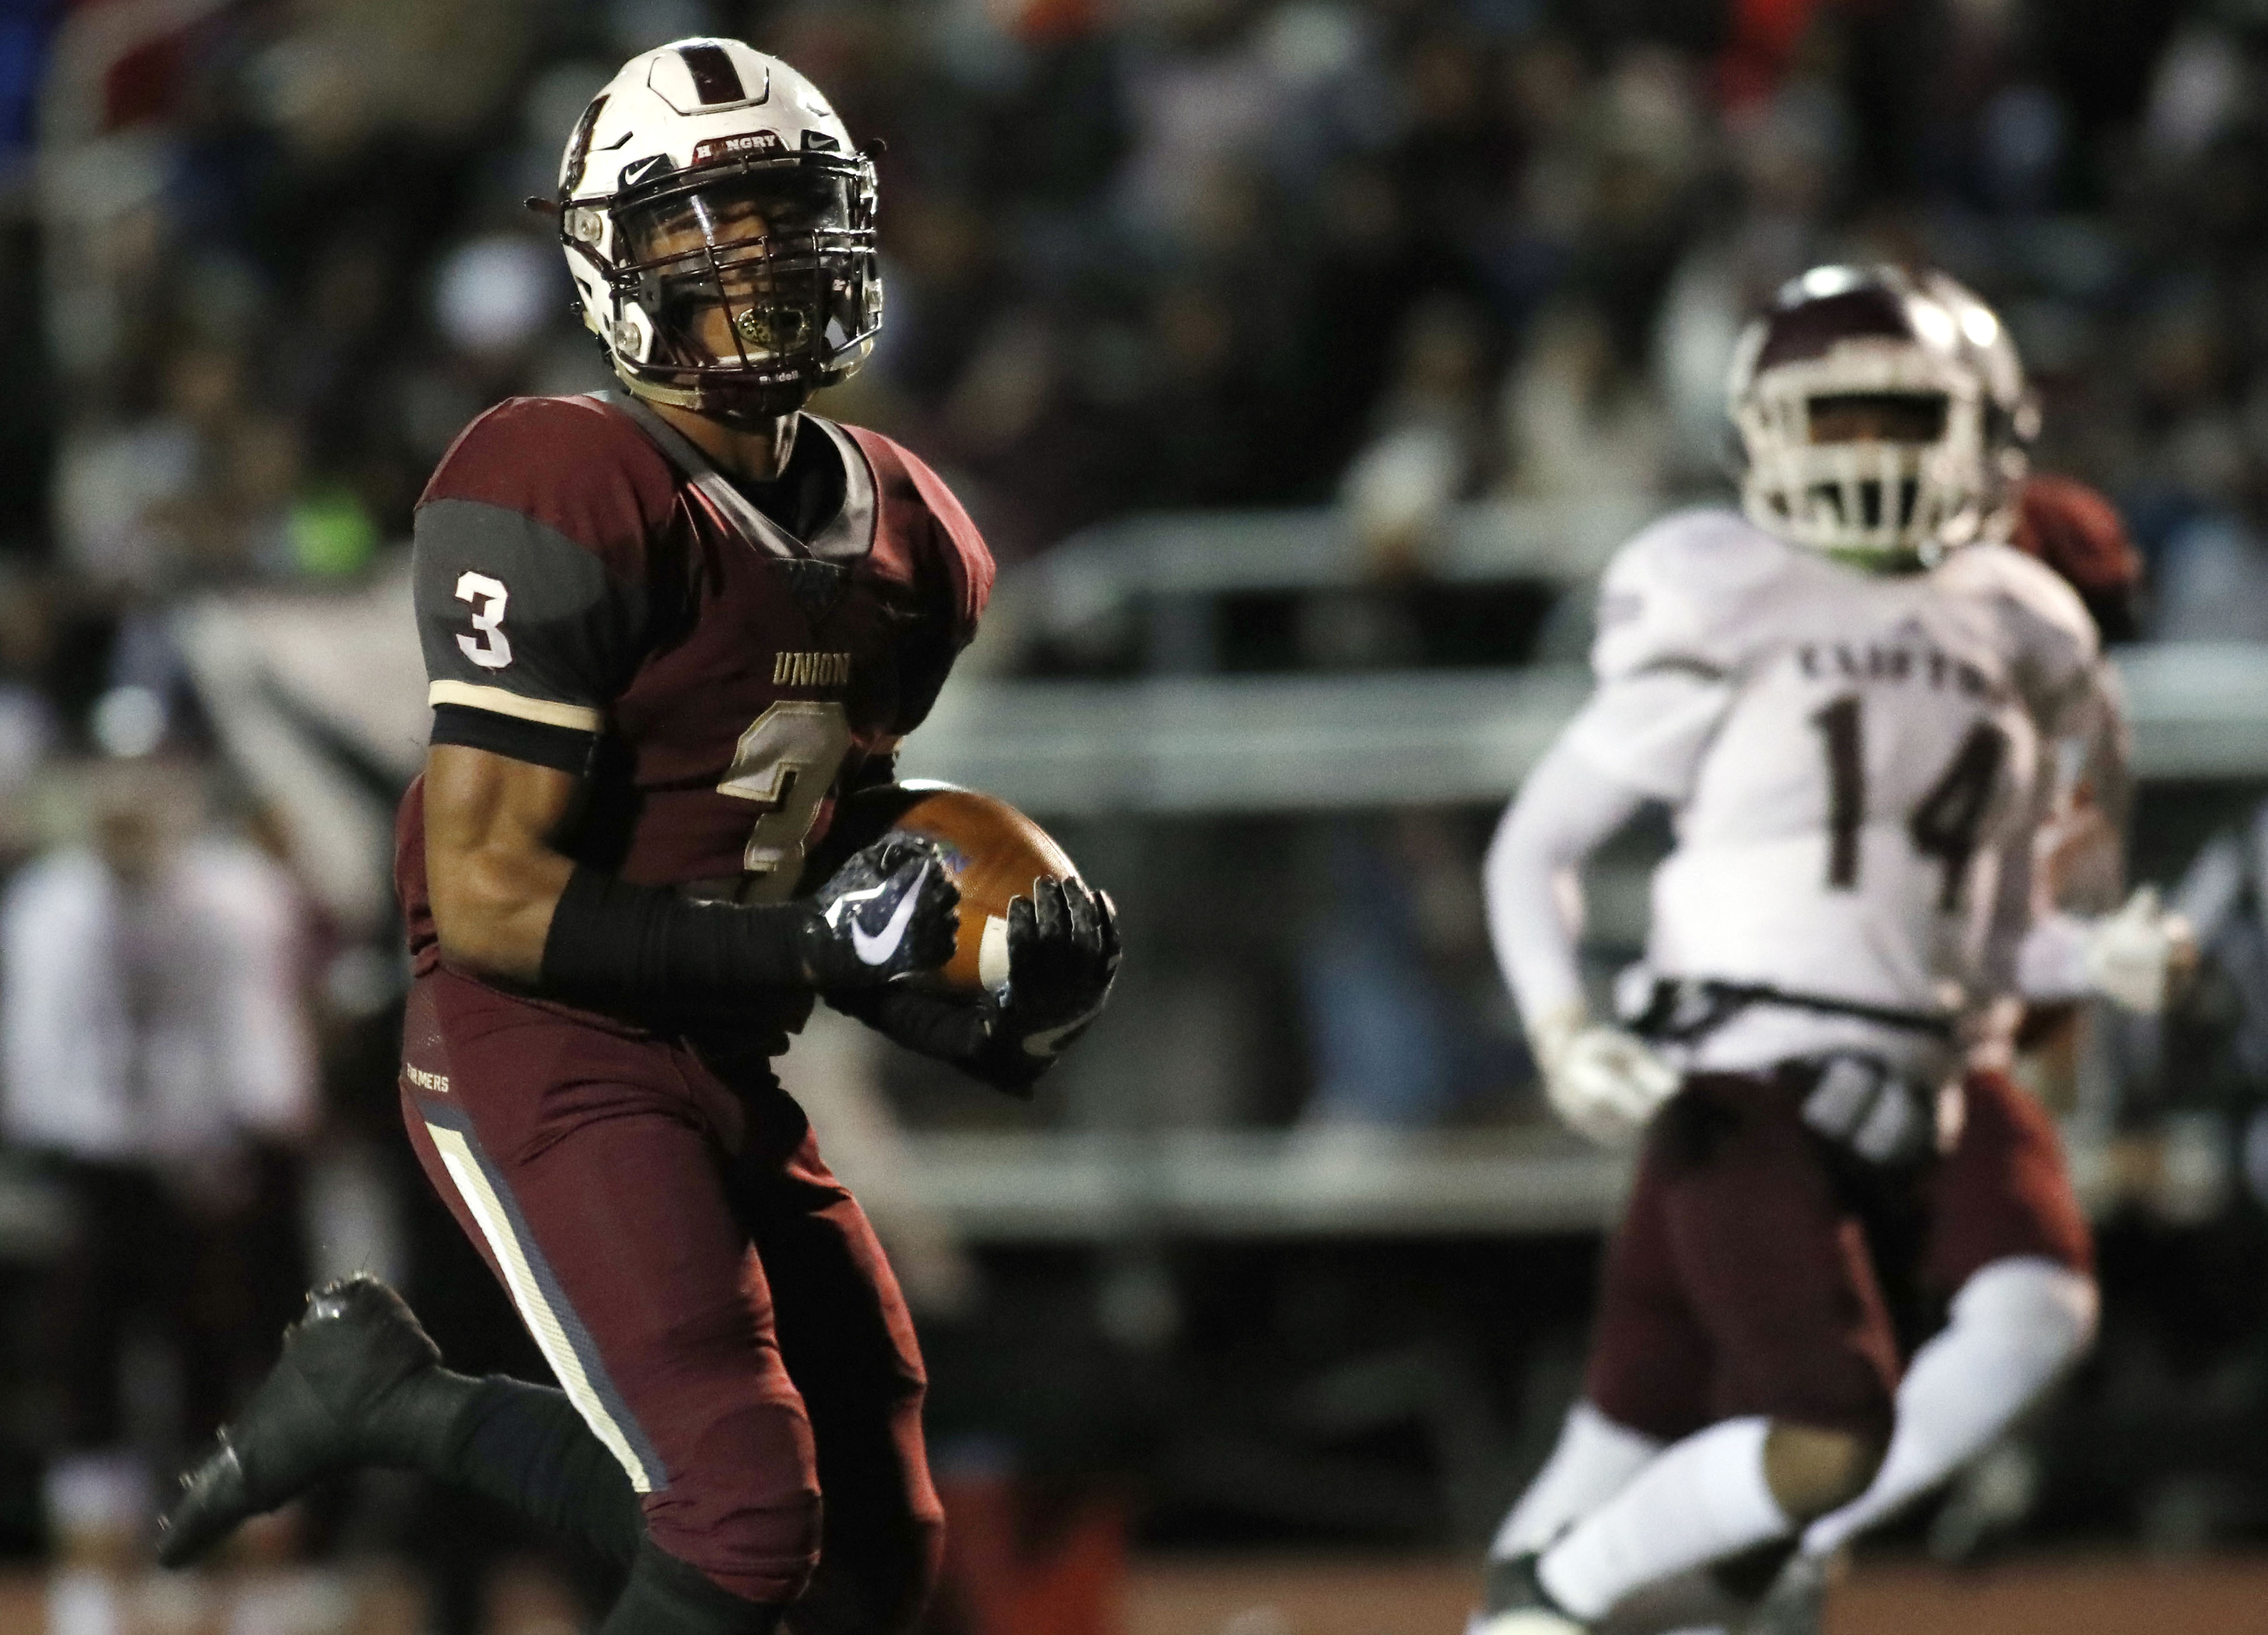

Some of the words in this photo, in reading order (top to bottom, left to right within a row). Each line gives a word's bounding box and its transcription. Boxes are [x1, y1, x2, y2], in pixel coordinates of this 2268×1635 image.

[696, 134, 776, 159] HNGRY
[455, 571, 513, 668] 3
[773, 652, 850, 686] UNION
[707, 700, 852, 903] 3
[1811, 695, 2009, 912] 14
